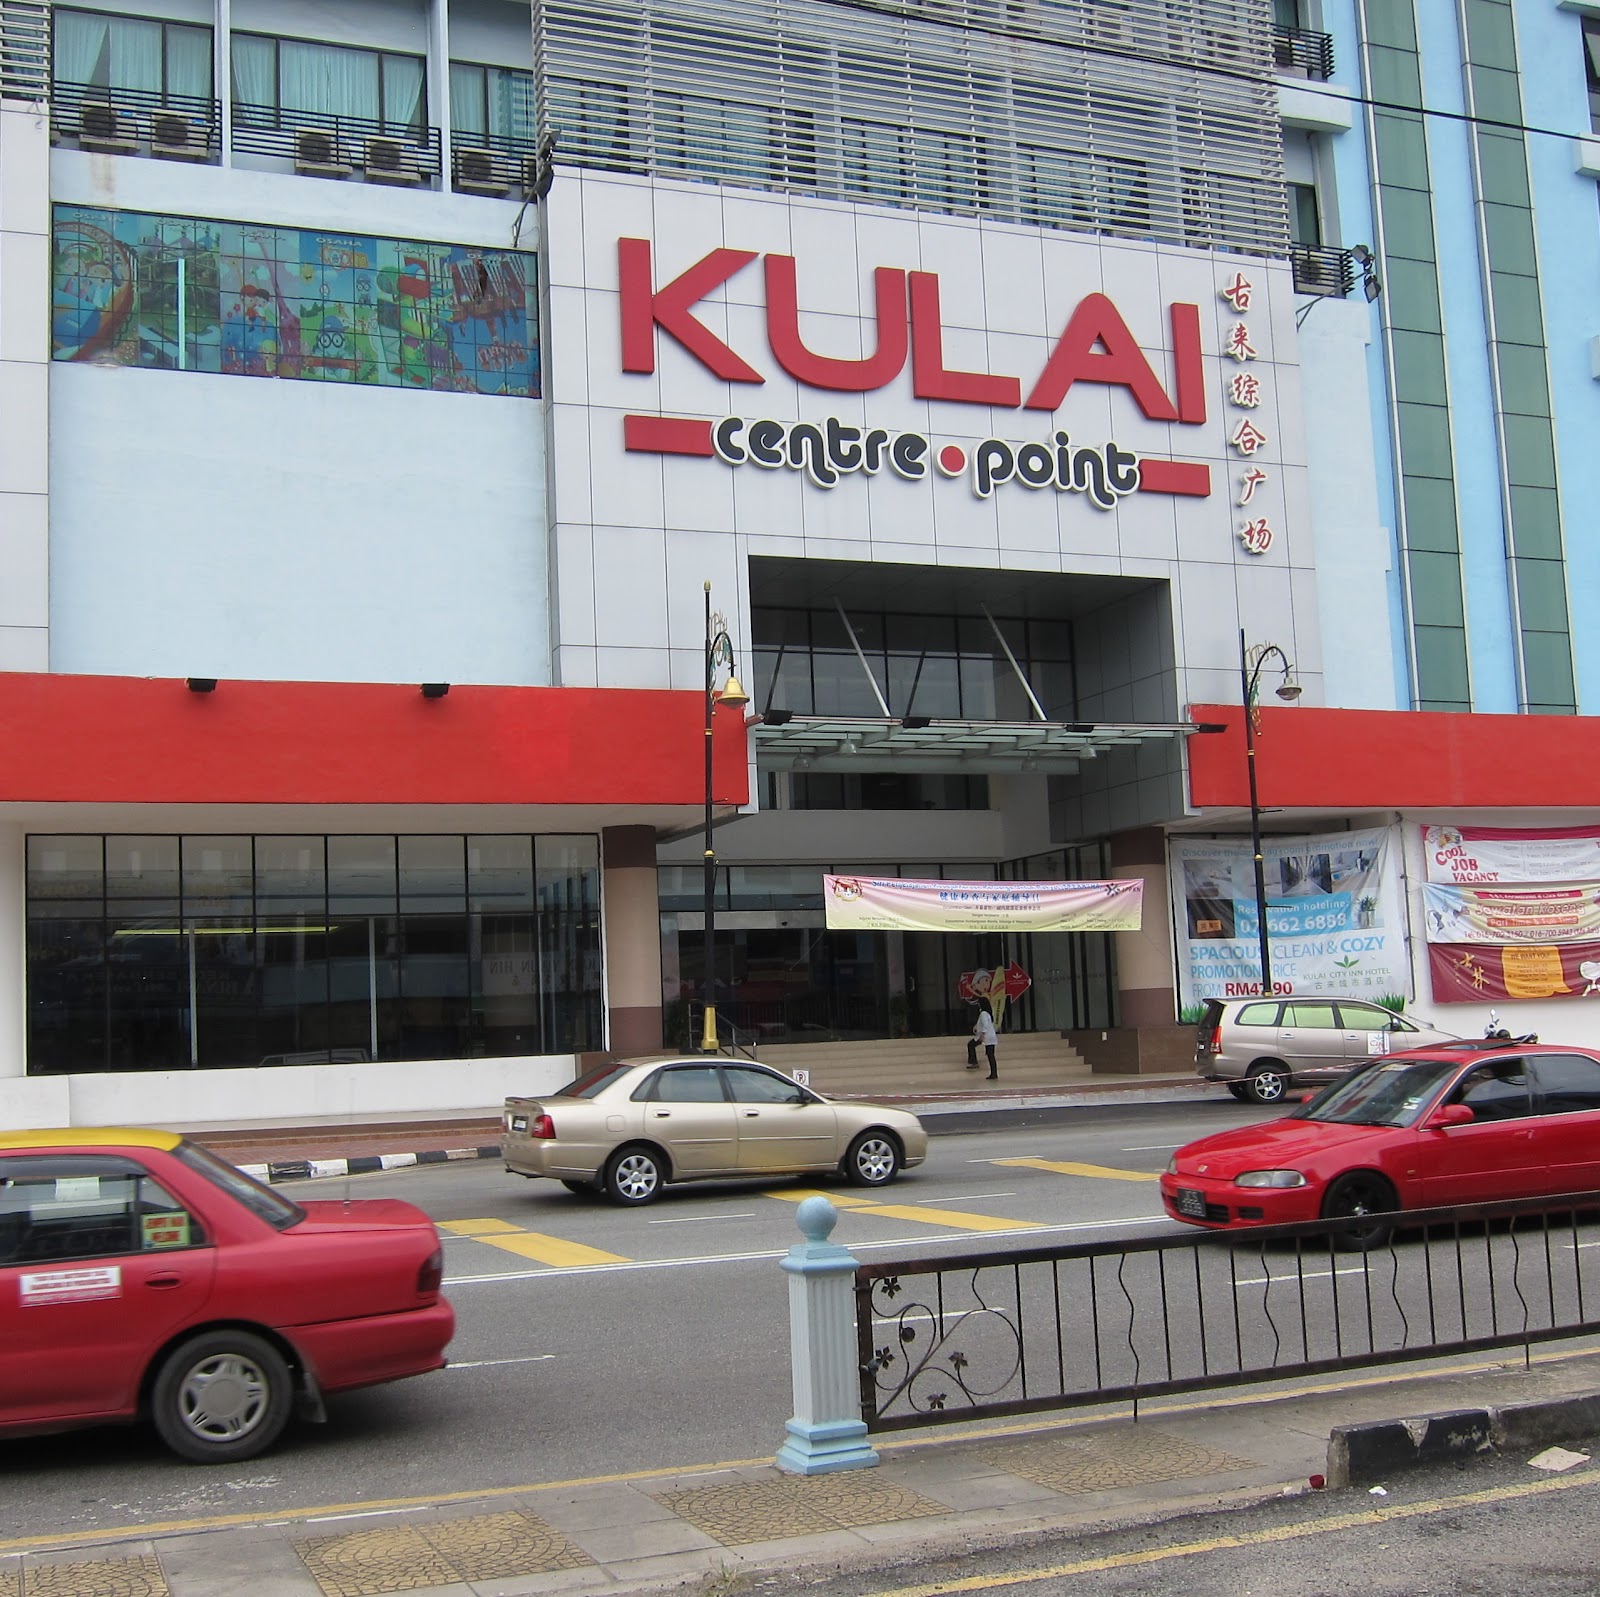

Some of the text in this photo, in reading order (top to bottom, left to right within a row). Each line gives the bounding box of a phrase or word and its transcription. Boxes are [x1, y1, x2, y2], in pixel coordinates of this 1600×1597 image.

[617, 236, 1206, 425] KULAI
[1221, 271, 1275, 556] 古来综合广场
[713, 416, 1141, 511] centre point
[1306, 839, 1354, 854] promotion
[1435, 846, 1467, 866] COOL
[1451, 858, 1478, 871] JOB
[1452, 872, 1499, 882] VACANCY
[1238, 901, 1300, 914] Resvation
[1267, 917, 1300, 932] 662
[1304, 912, 1347, 931] 6888
[1273, 943, 1323, 958] CLEAN
[1326, 941, 1338, 954] &
[1340, 936, 1385, 952] COZY
[1272, 963, 1297, 977] RICE
[1329, 971, 1348, 979] CITY
[1365, 967, 1391, 976] HOTEL
[1192, 984, 1222, 997] FROM
